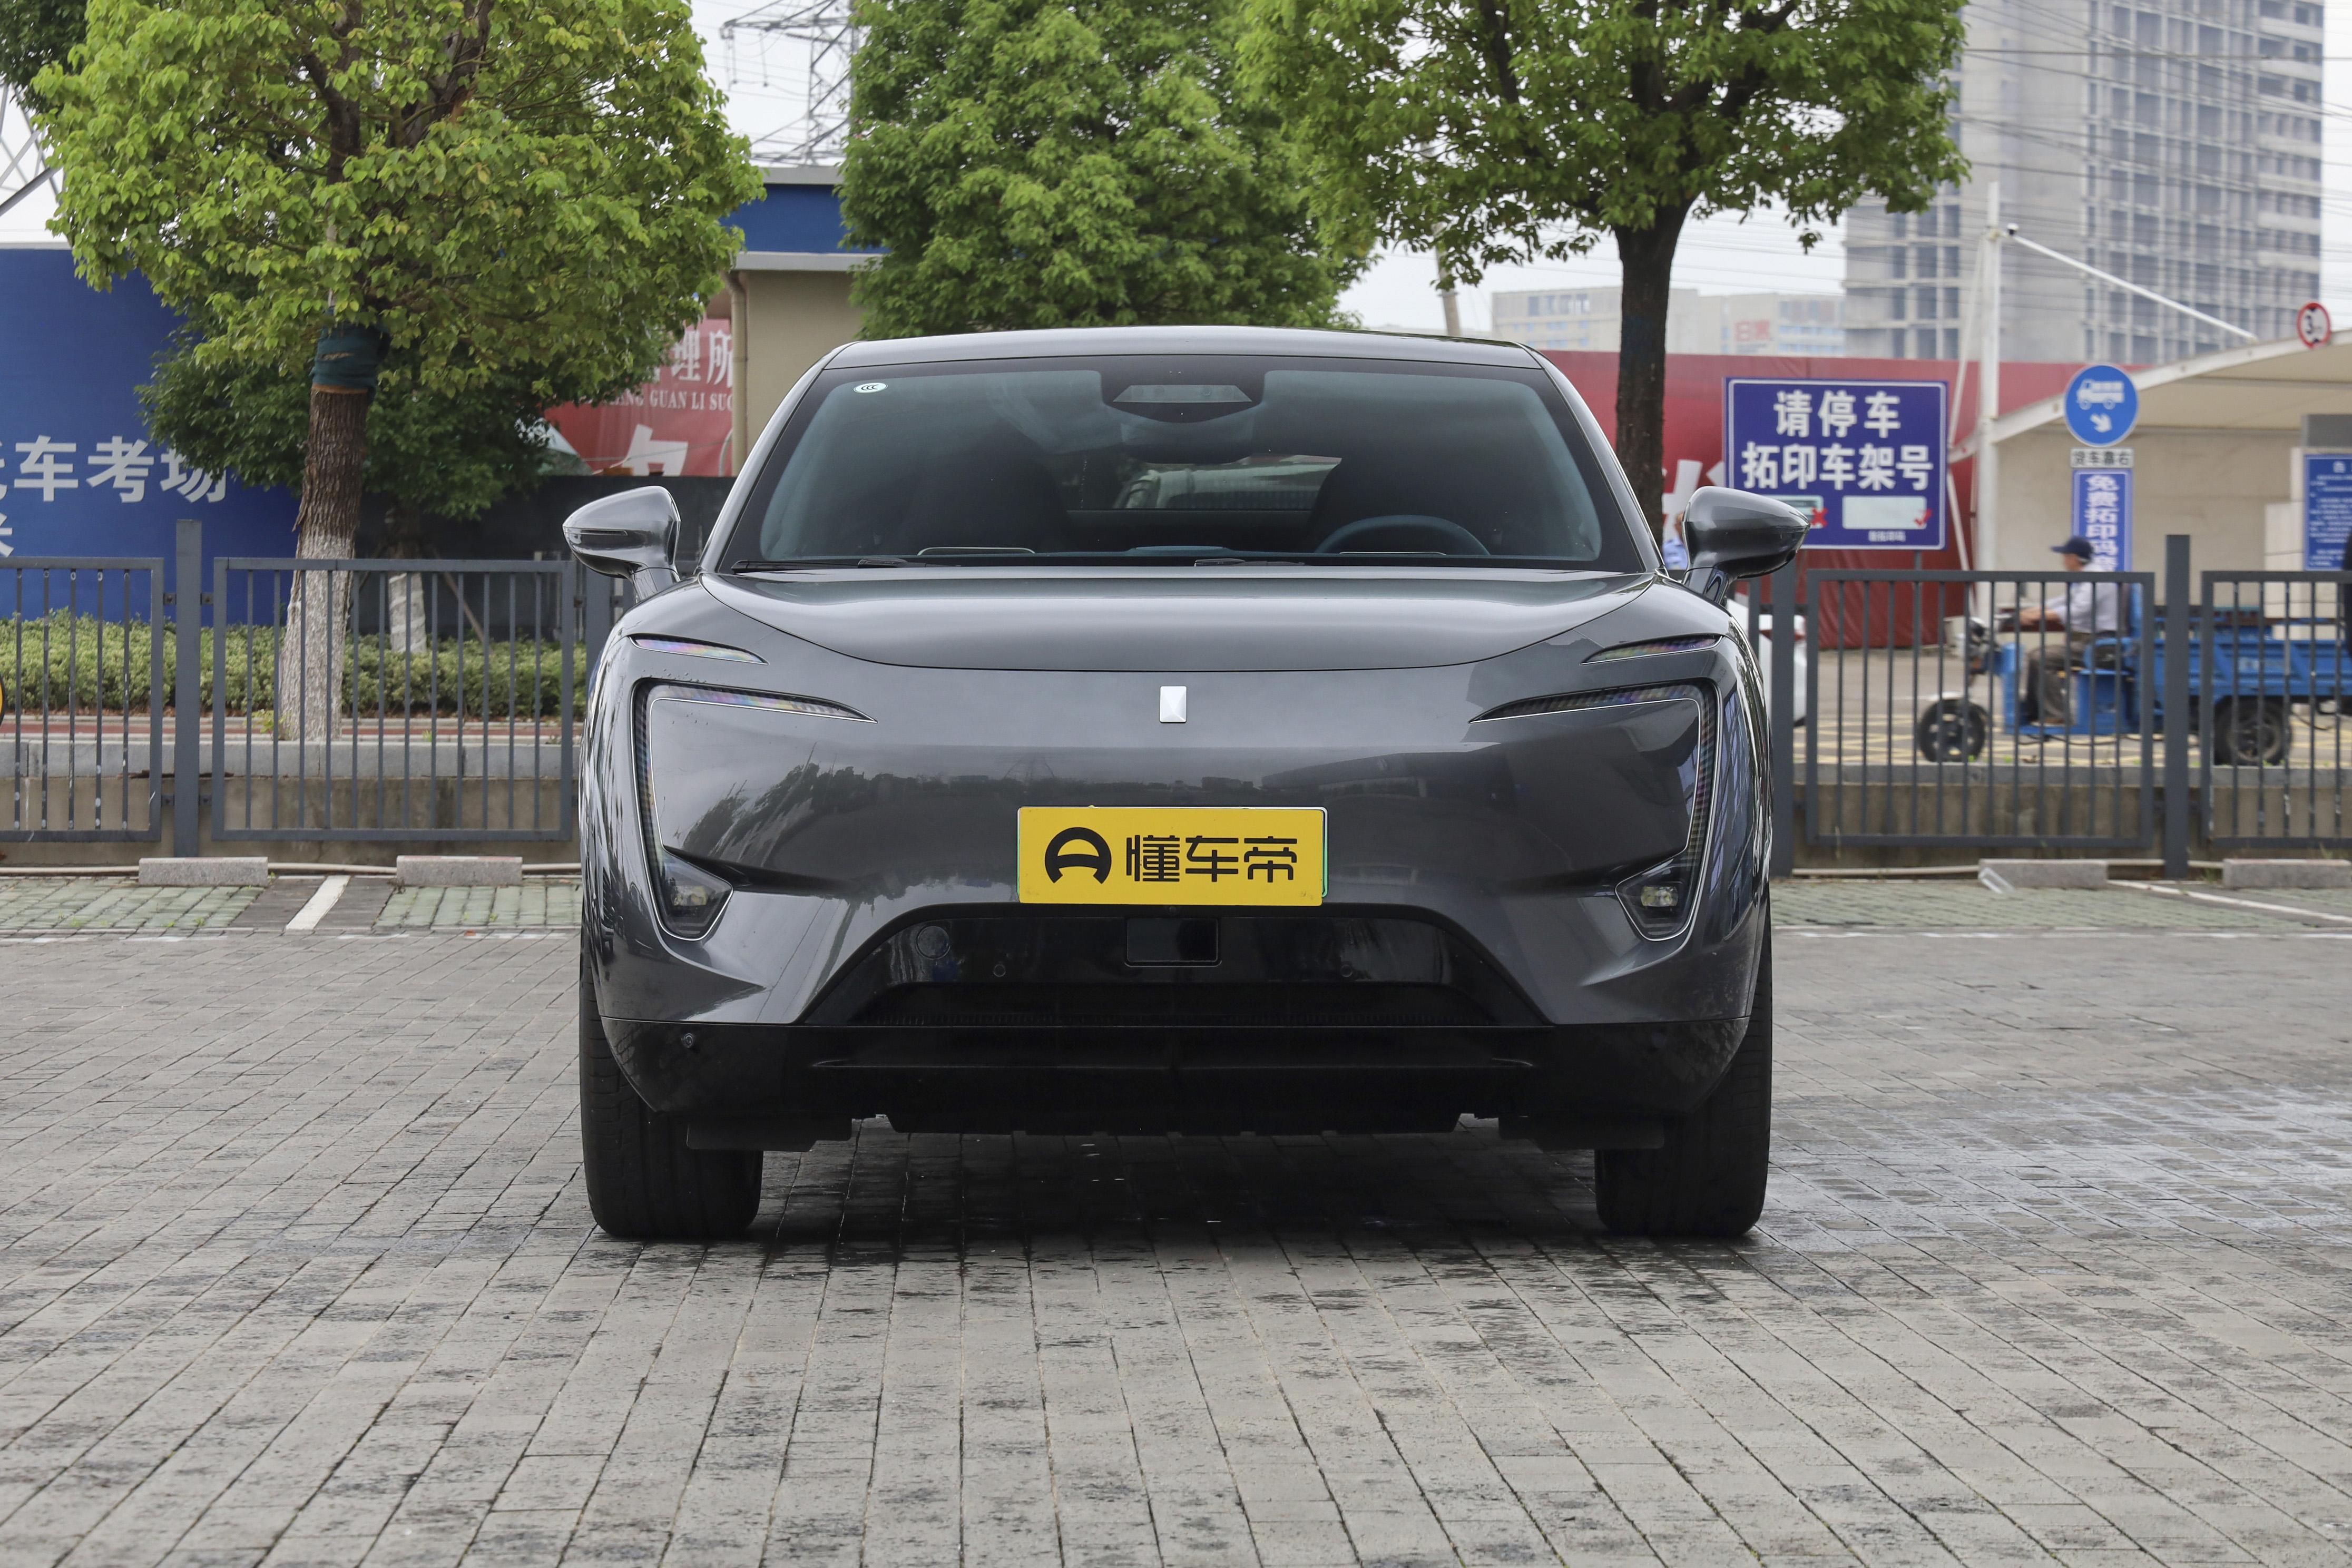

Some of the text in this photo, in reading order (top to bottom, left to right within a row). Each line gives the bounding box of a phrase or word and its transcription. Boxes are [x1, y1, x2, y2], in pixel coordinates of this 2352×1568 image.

[649, 389, 687, 409] GUAN
[691, 391, 705, 410] LI
[1773, 389, 1900, 438] 请停车
[0, 435, 227, 503] 车考场
[1741, 442, 1934, 491] 拓印车架号
[1126, 835, 1298, 883] 懂车帝
